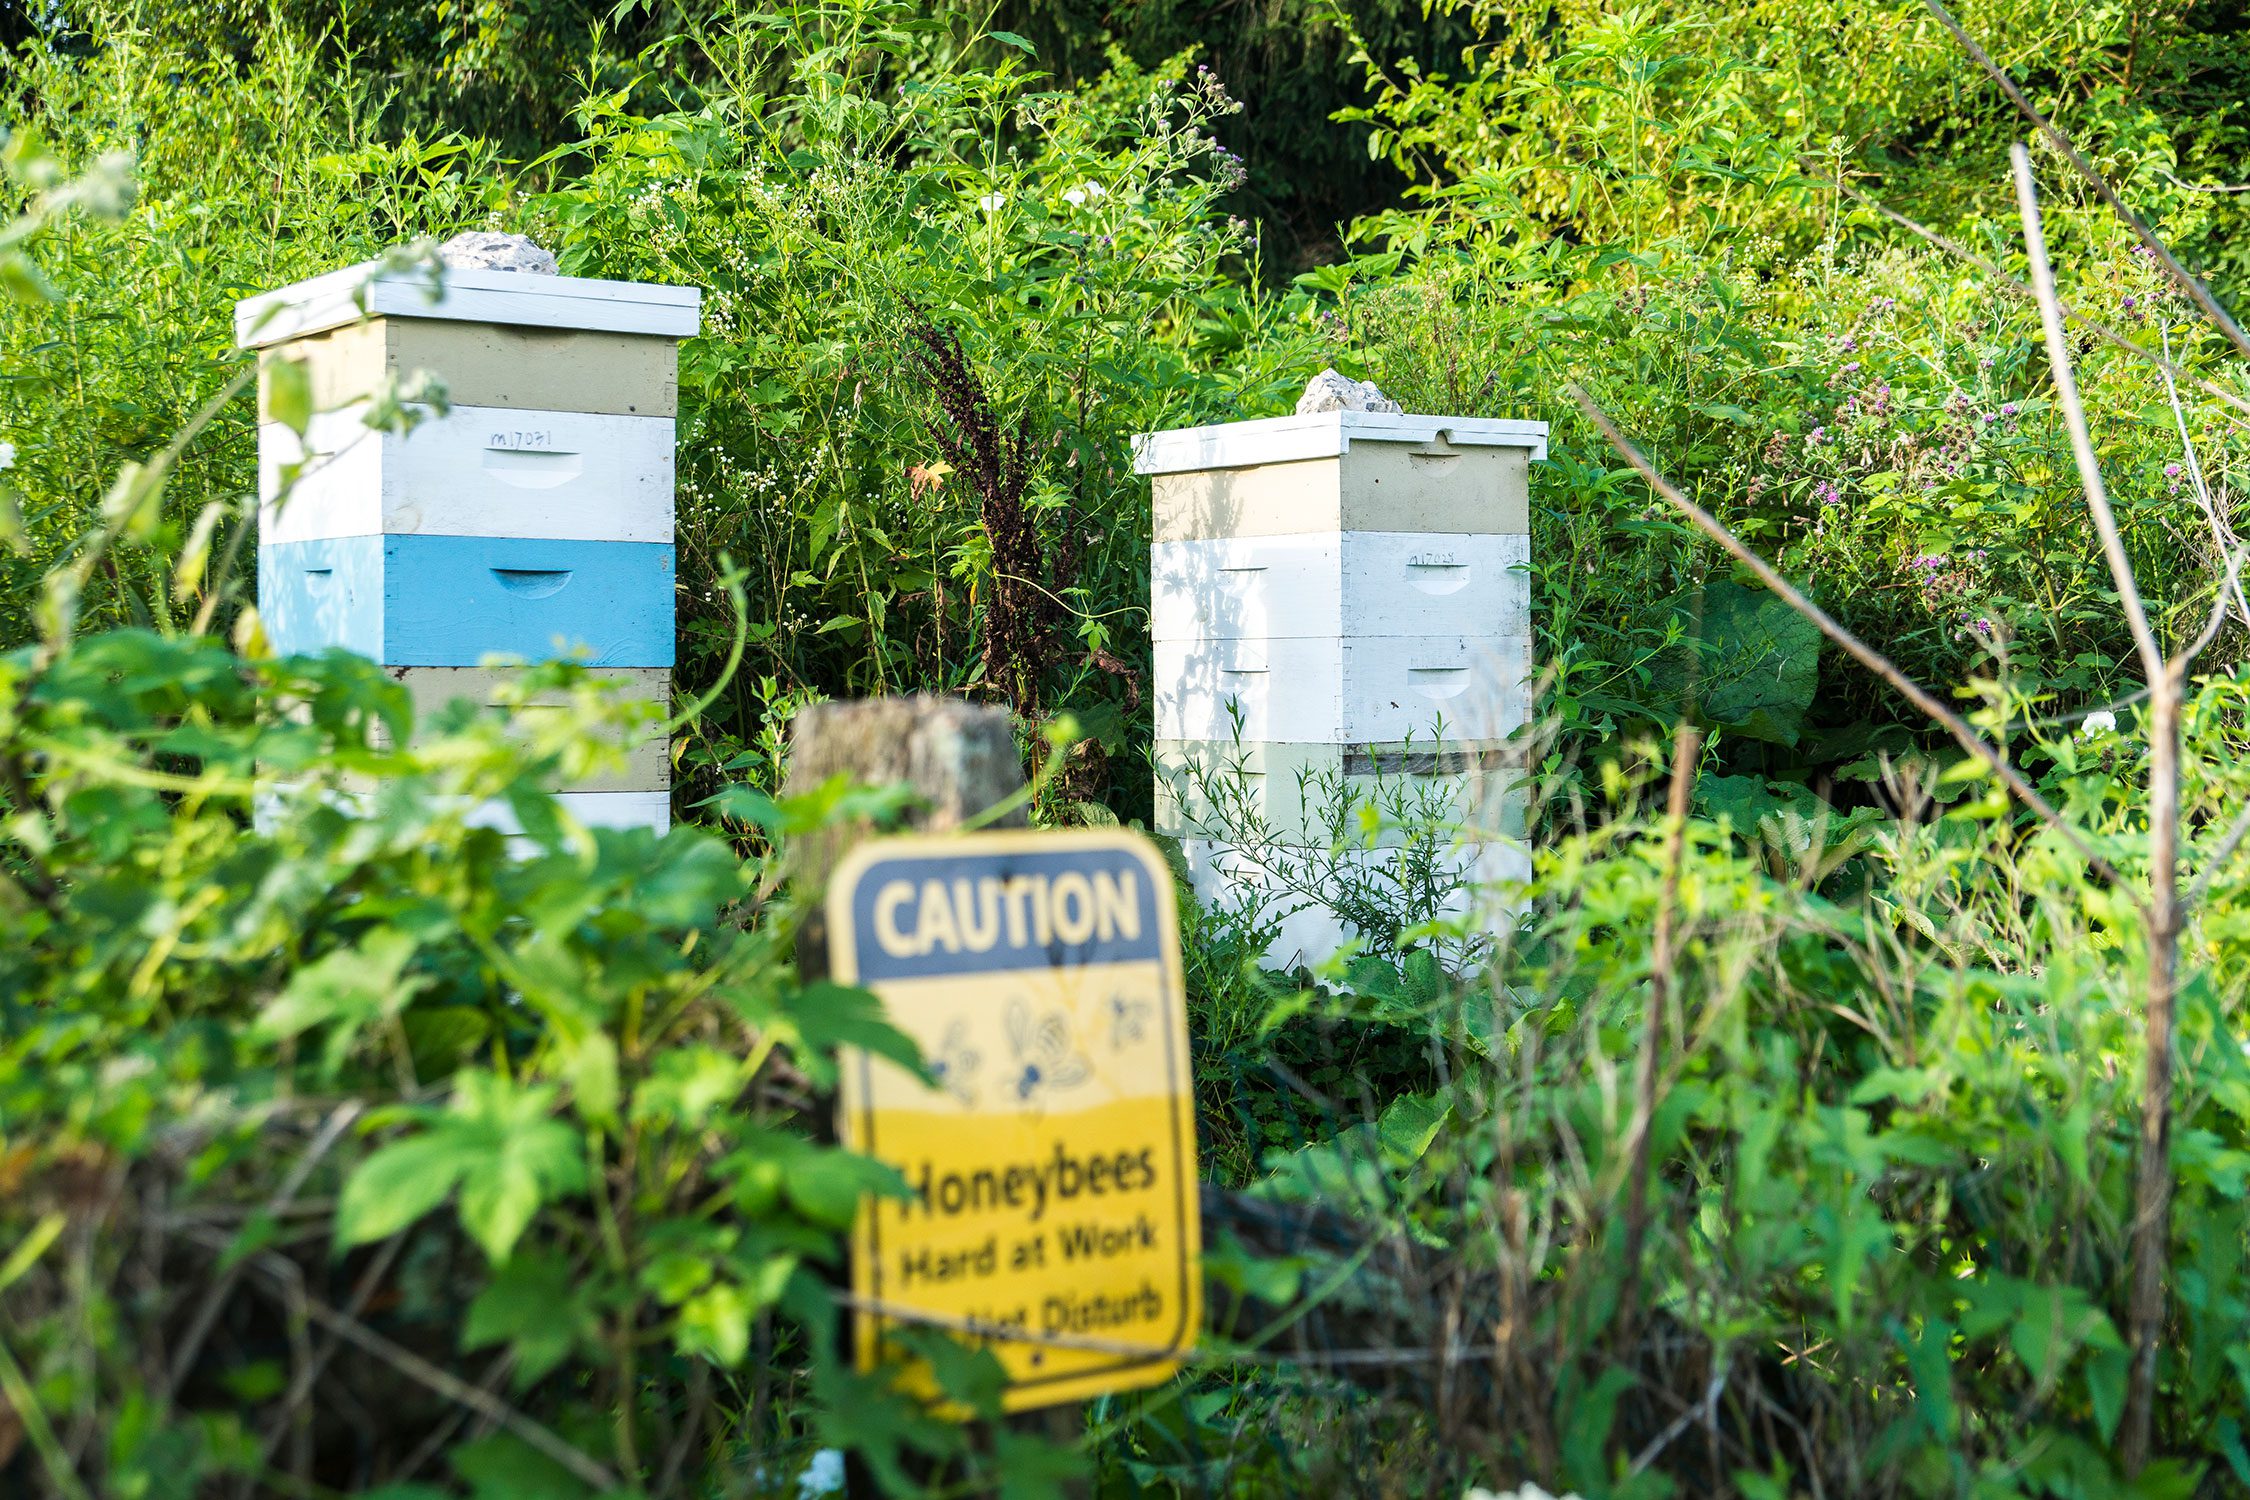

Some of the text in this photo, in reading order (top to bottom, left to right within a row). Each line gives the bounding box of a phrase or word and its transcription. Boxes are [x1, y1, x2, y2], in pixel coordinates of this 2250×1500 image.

[874, 869, 1141, 957] CAUTION
[901, 1142, 1156, 1221] Honeybees
[901, 1214, 1157, 1287] Hard at Work
[1042, 1281, 1162, 1338] Disturb
